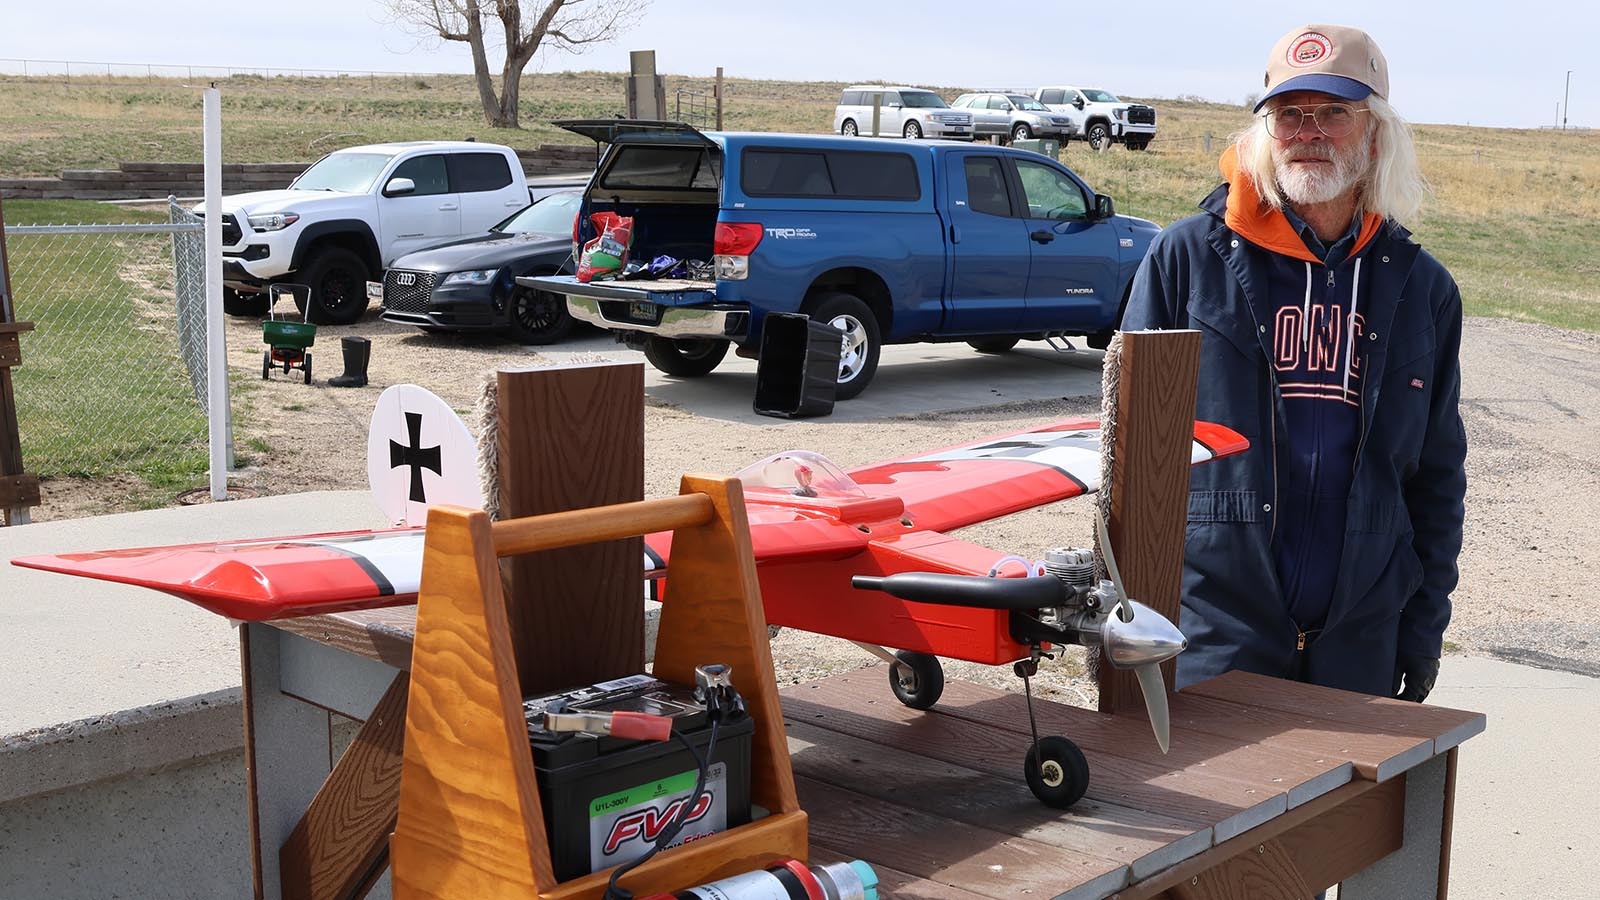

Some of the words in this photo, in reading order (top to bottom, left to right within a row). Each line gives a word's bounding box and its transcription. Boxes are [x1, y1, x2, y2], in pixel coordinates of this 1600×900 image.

[1065, 287, 1094, 295] TUNDRA
[595, 795, 630, 813] U1L-300V
[602, 790, 714, 856] FVP
